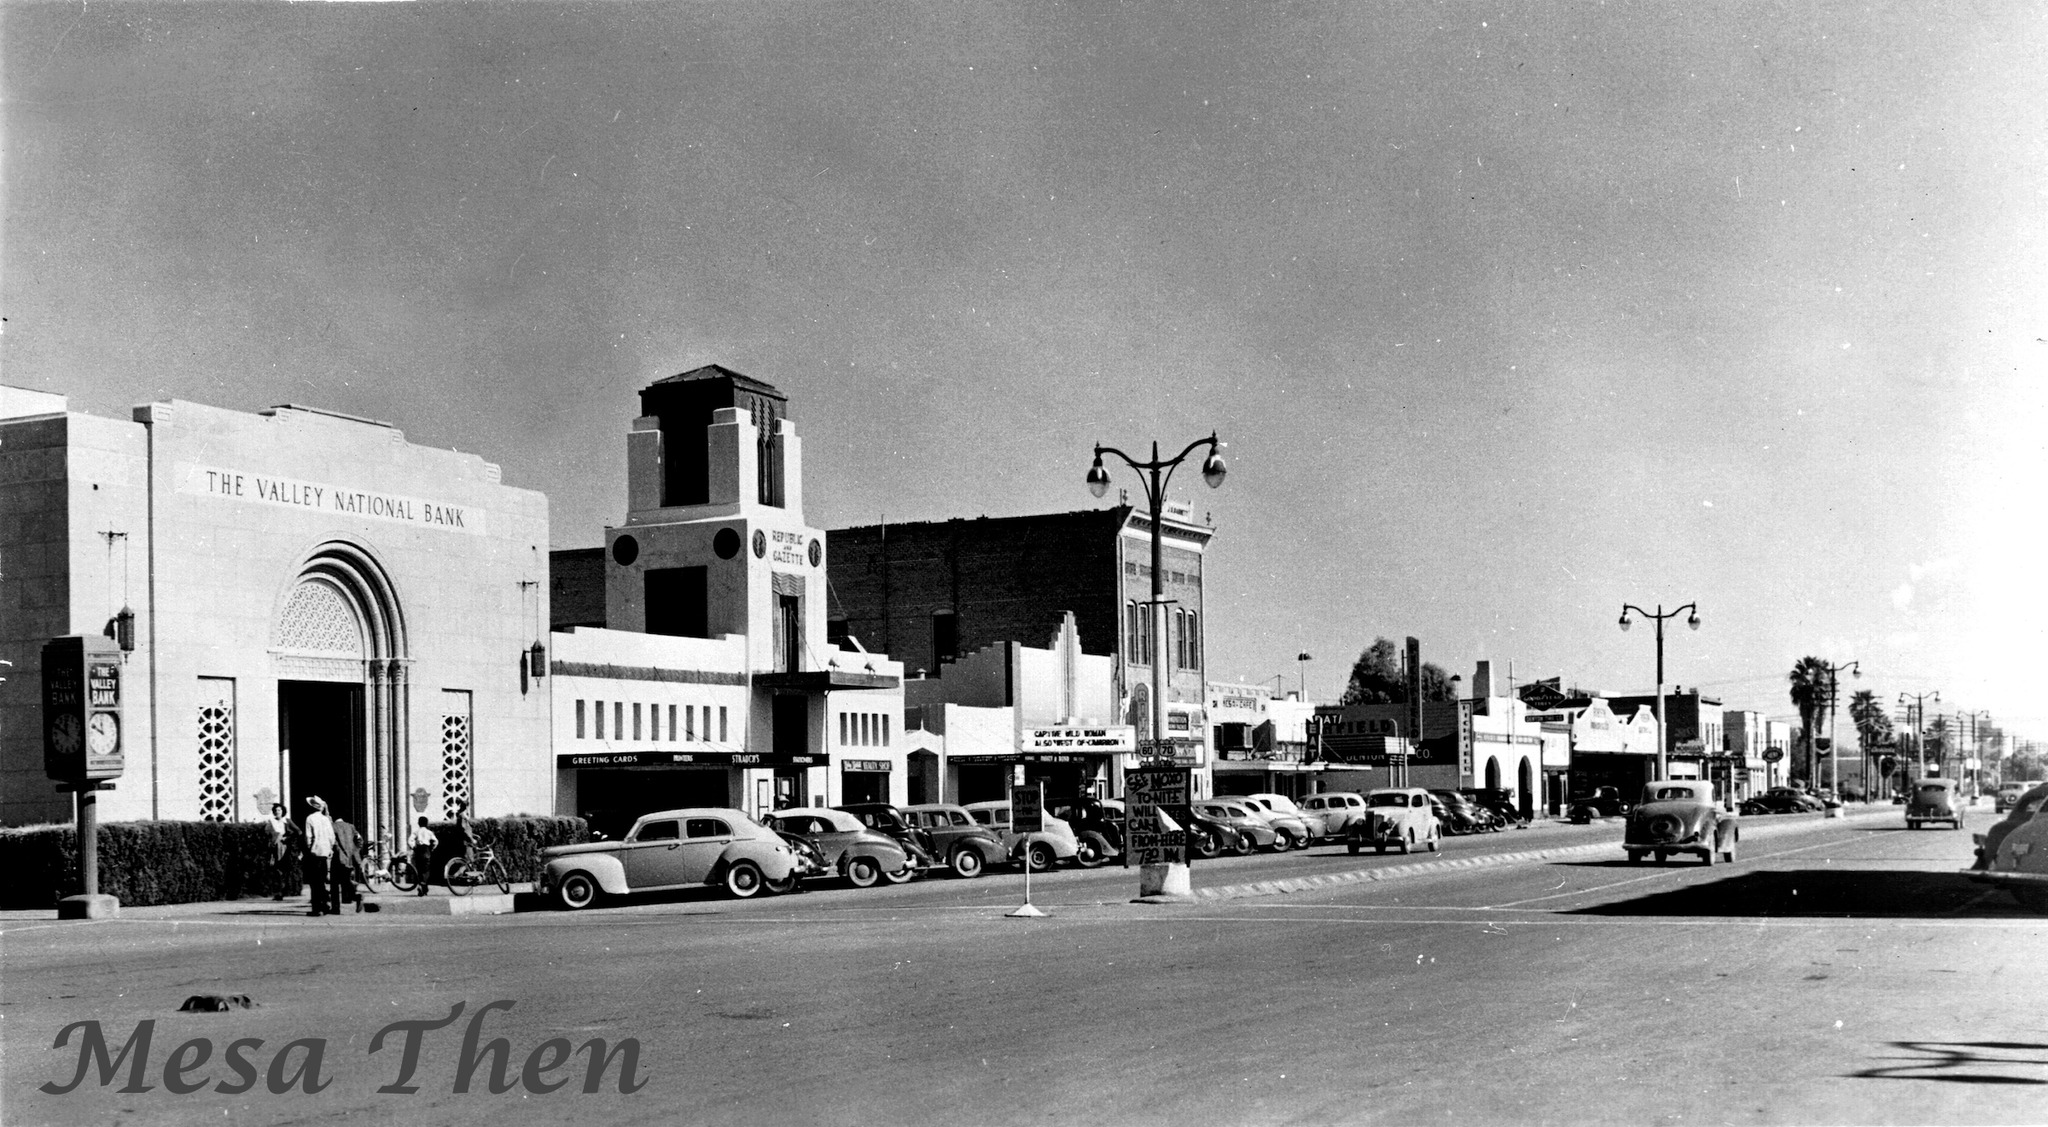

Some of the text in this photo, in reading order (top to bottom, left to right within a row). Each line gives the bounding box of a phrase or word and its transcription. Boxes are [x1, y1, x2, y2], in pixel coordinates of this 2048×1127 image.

[206, 470, 465, 528] THE VALLEY NATIONAL BANK
[772, 530, 803, 546] REPUBLIC
[773, 551, 804, 566] GAZETTE
[97, 666, 110, 677] THE
[90, 678, 117, 690] VALLEY
[92, 690, 116, 705] BANK
[1142, 746, 1154, 756] 60
[1161, 745, 1174, 756] 70
[572, 755, 638, 765] GREETING CARDS
[1014, 790, 1039, 805] STOP
[1132, 804, 1158, 817] WILL
